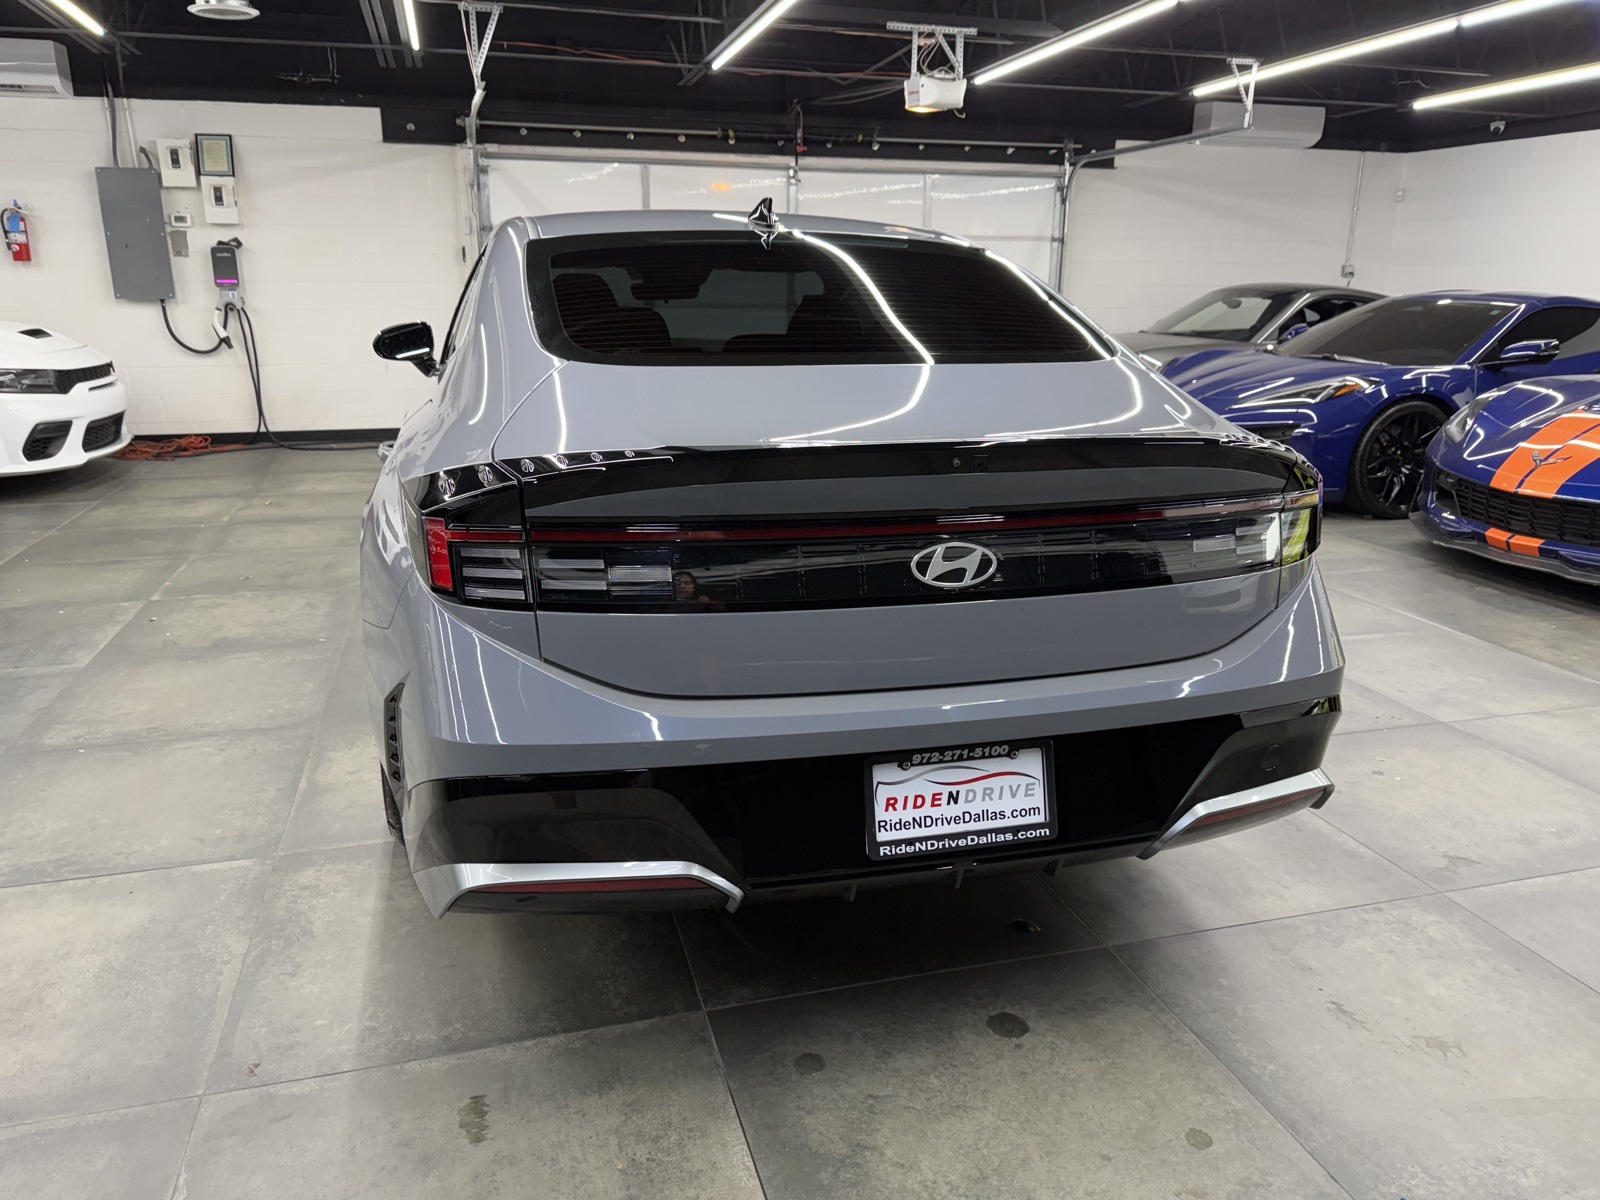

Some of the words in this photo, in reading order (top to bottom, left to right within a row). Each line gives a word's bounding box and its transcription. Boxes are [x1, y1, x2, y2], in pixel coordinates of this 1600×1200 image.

[911, 744, 1009, 765] 972-271-5100
[877, 806, 1041, 833] RideNDriveDallas.com
[879, 827, 1050, 856] RideNDriveDallas.com
